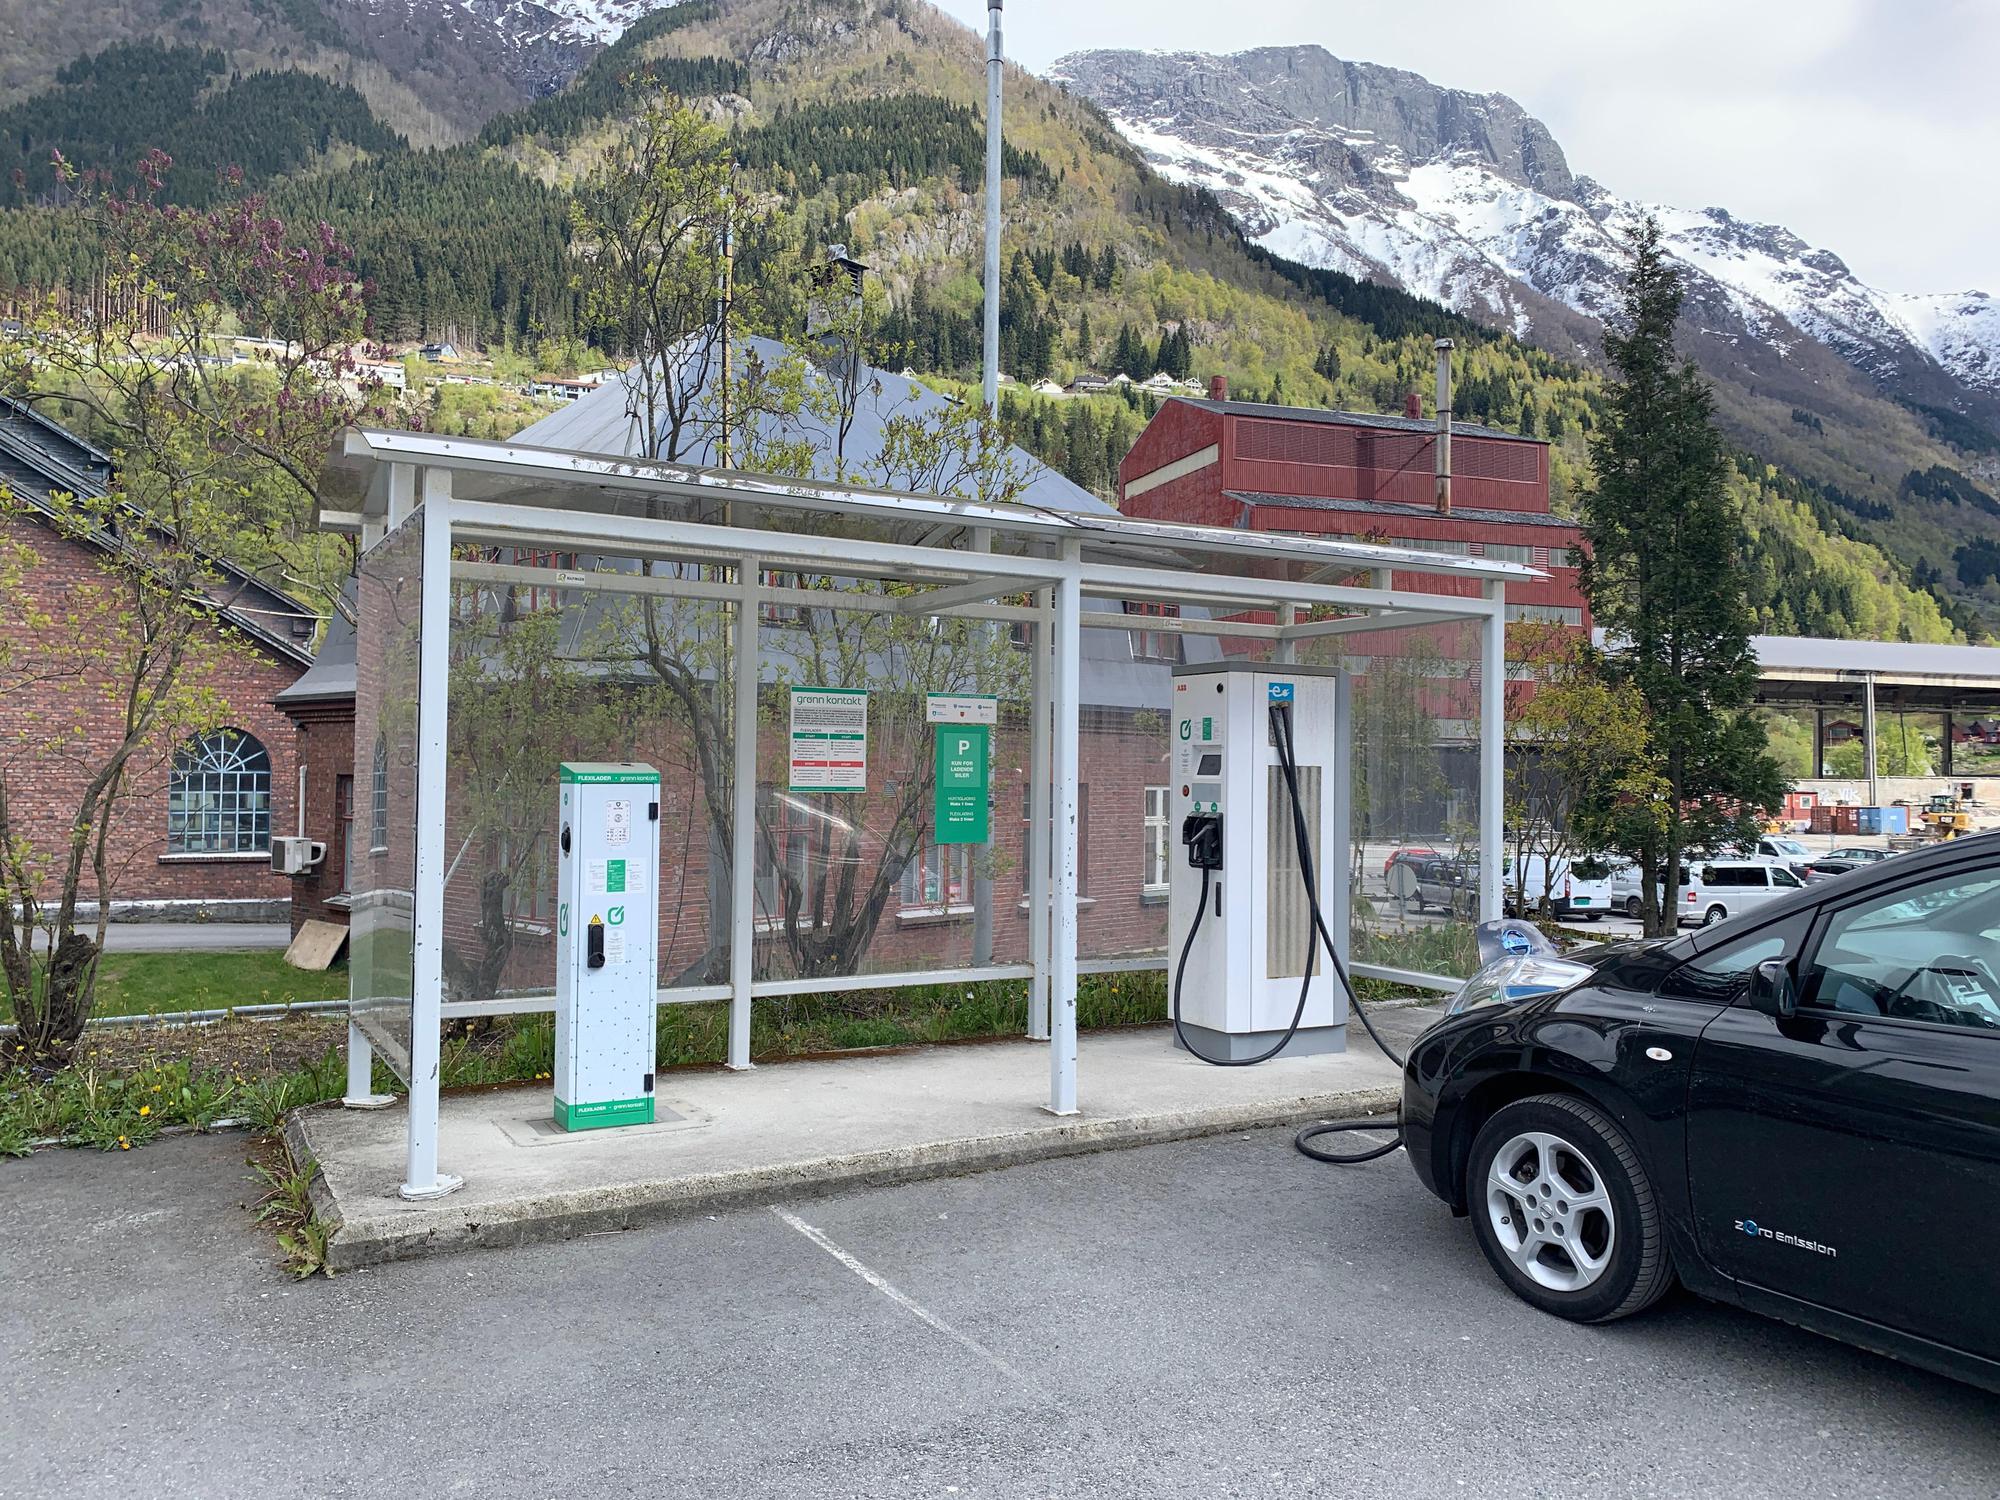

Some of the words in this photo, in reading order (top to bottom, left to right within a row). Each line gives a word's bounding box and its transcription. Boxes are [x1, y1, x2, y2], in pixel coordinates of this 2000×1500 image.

[796, 695, 824, 705] grønn
[826, 696, 862, 706] kontakt
[958, 740, 970, 755] P
[578, 1105, 607, 1113] FLEXILADER
